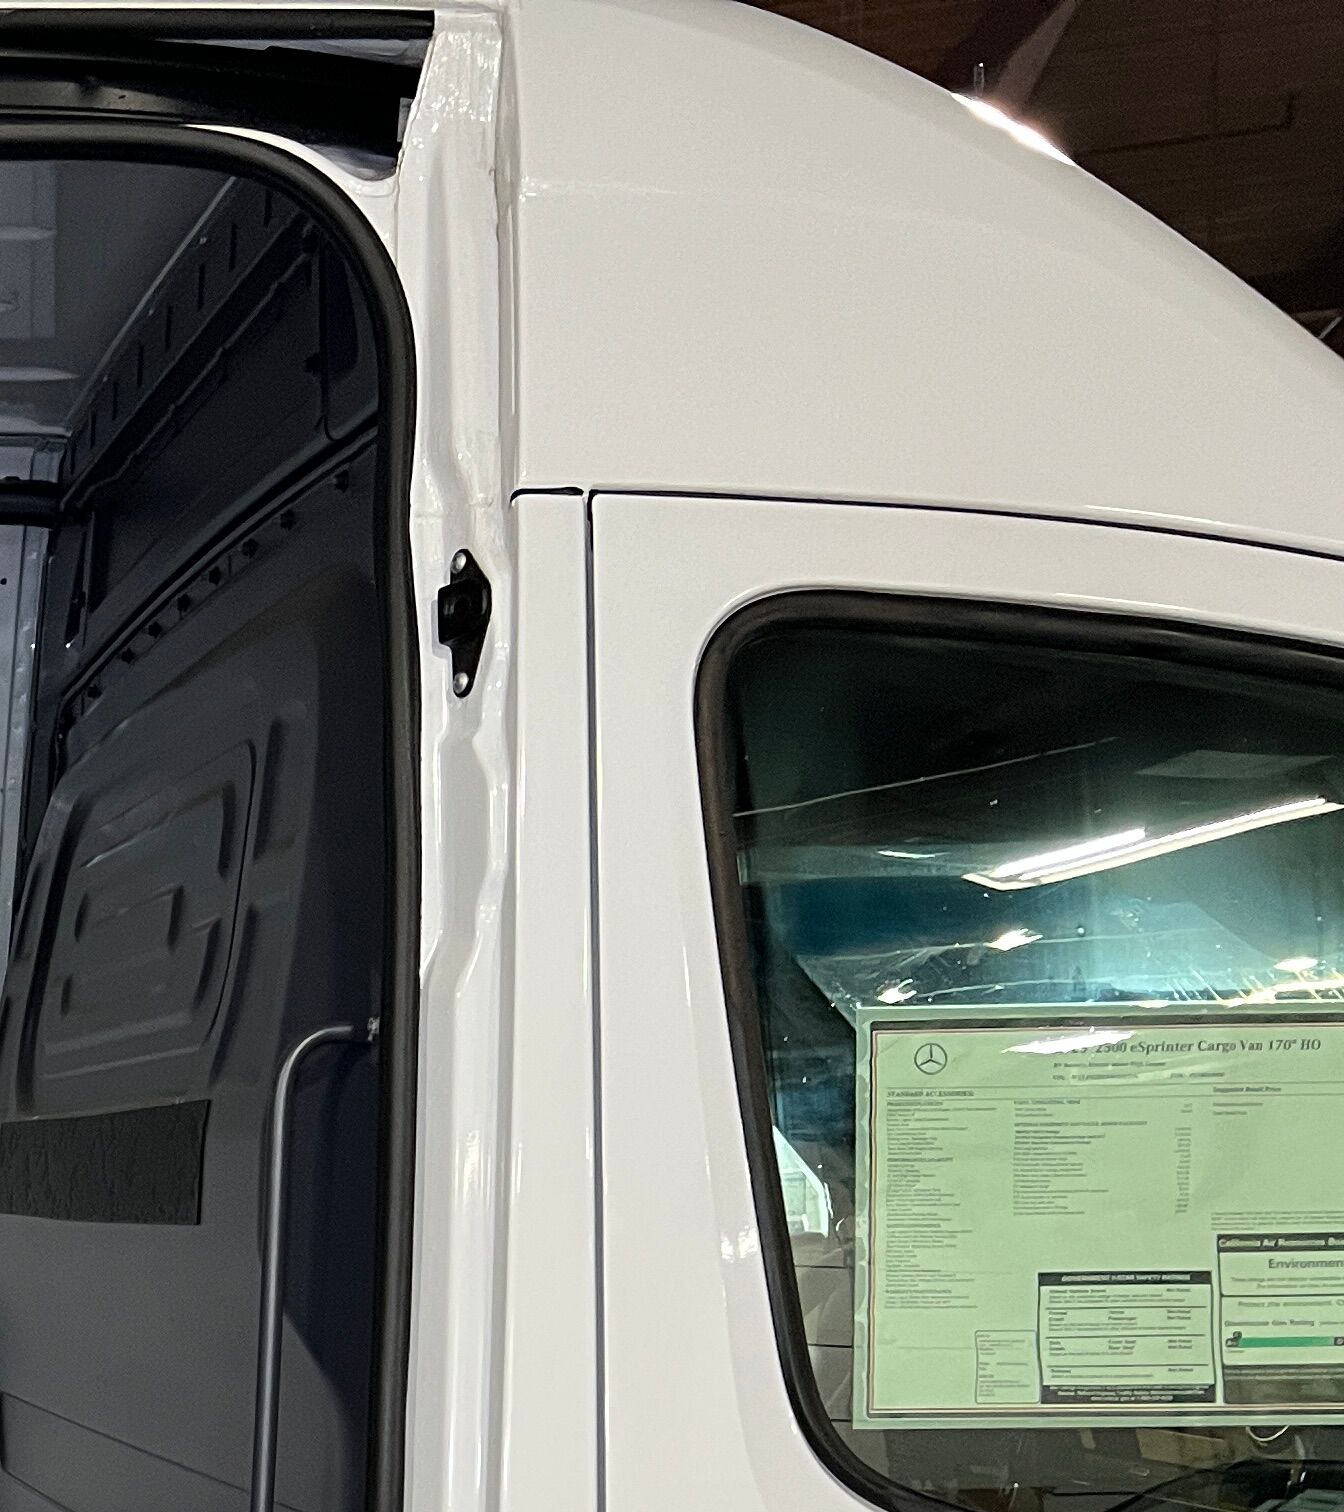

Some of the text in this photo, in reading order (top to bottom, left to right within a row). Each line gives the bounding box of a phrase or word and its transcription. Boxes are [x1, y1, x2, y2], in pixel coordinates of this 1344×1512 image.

[1130, 1040, 1194, 1055] eSprinter
[1197, 1039, 1237, 1053] Cargo
[1240, 1039, 1263, 1051] Van
[1299, 1038, 1322, 1051] HO
